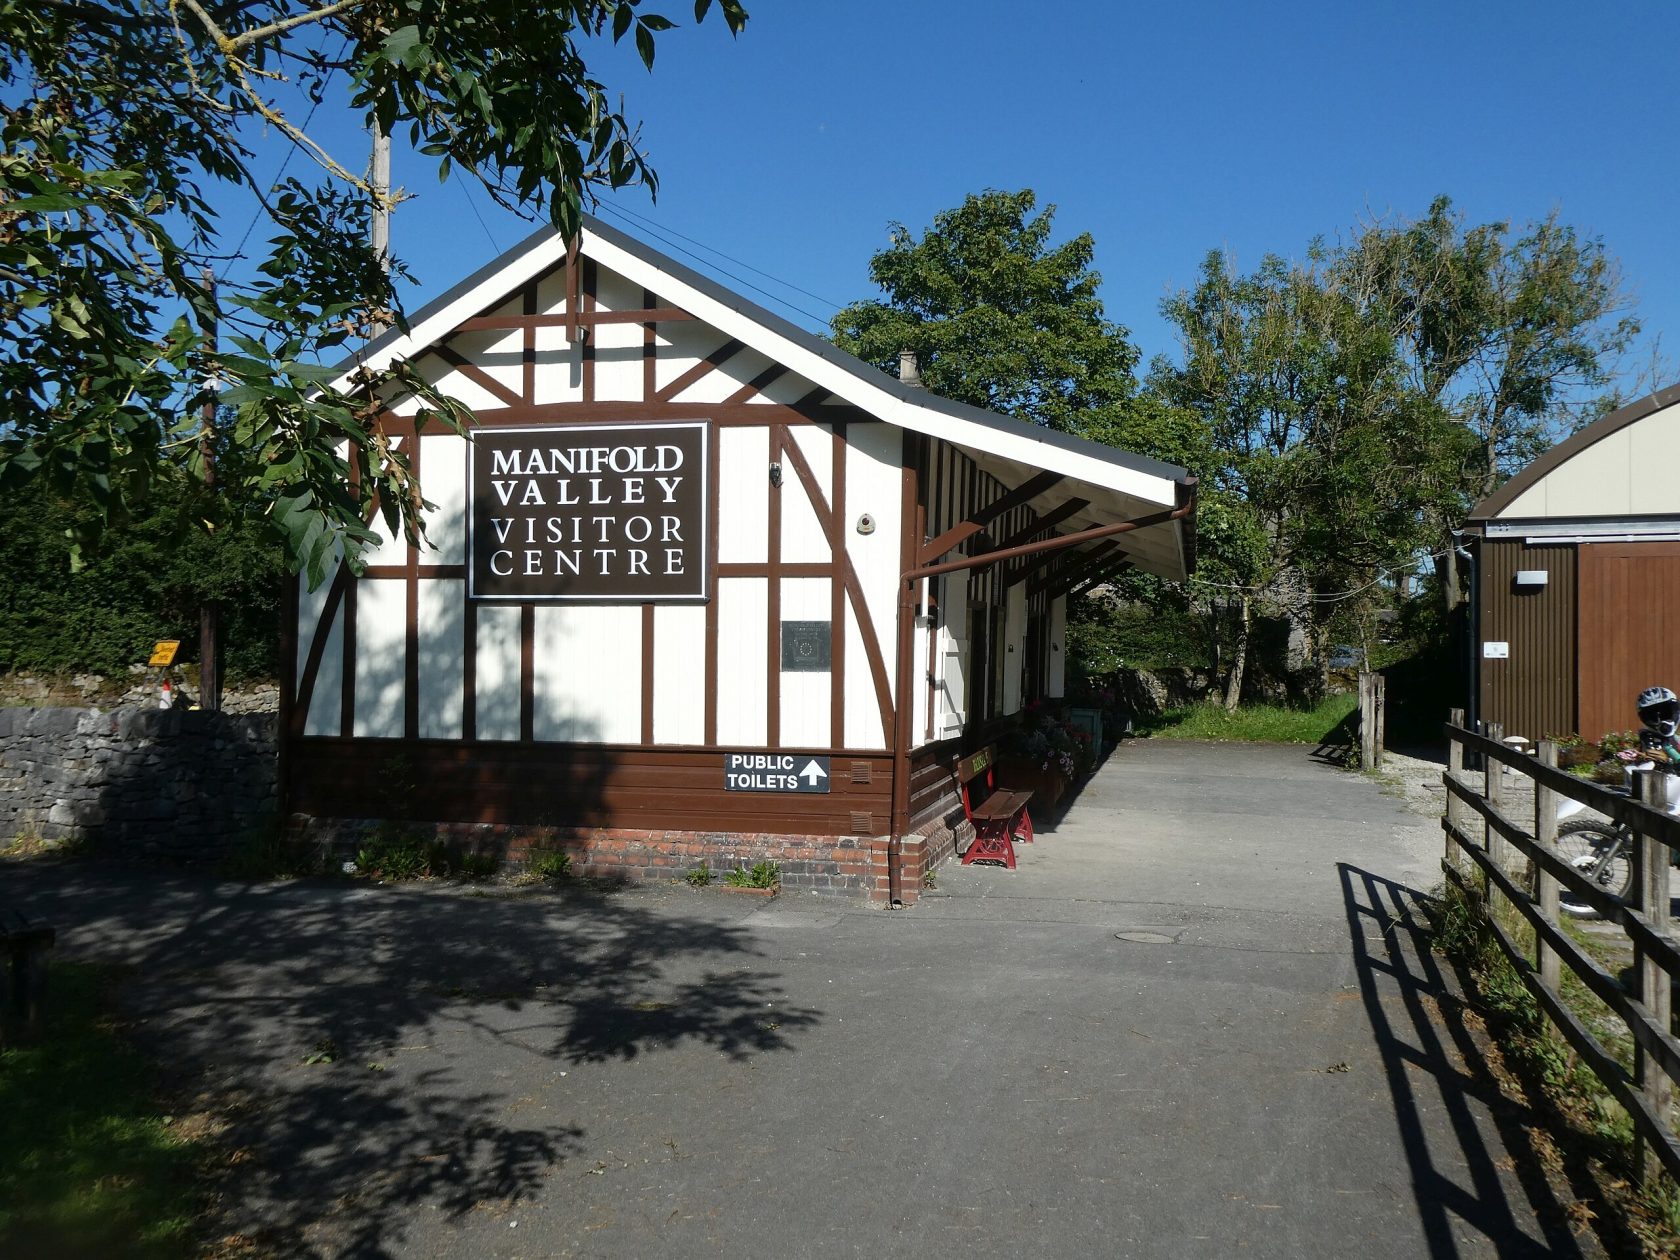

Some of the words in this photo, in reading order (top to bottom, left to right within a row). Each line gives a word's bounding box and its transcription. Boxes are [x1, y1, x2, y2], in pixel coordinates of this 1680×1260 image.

[491, 446, 684, 475] MANIFOLD
[491, 477, 683, 506] VALLEY
[491, 515, 684, 543] VISITOR
[490, 549, 685, 576] CENTRE
[731, 755, 794, 770] PUBLIC
[727, 774, 798, 789] TOILETS
